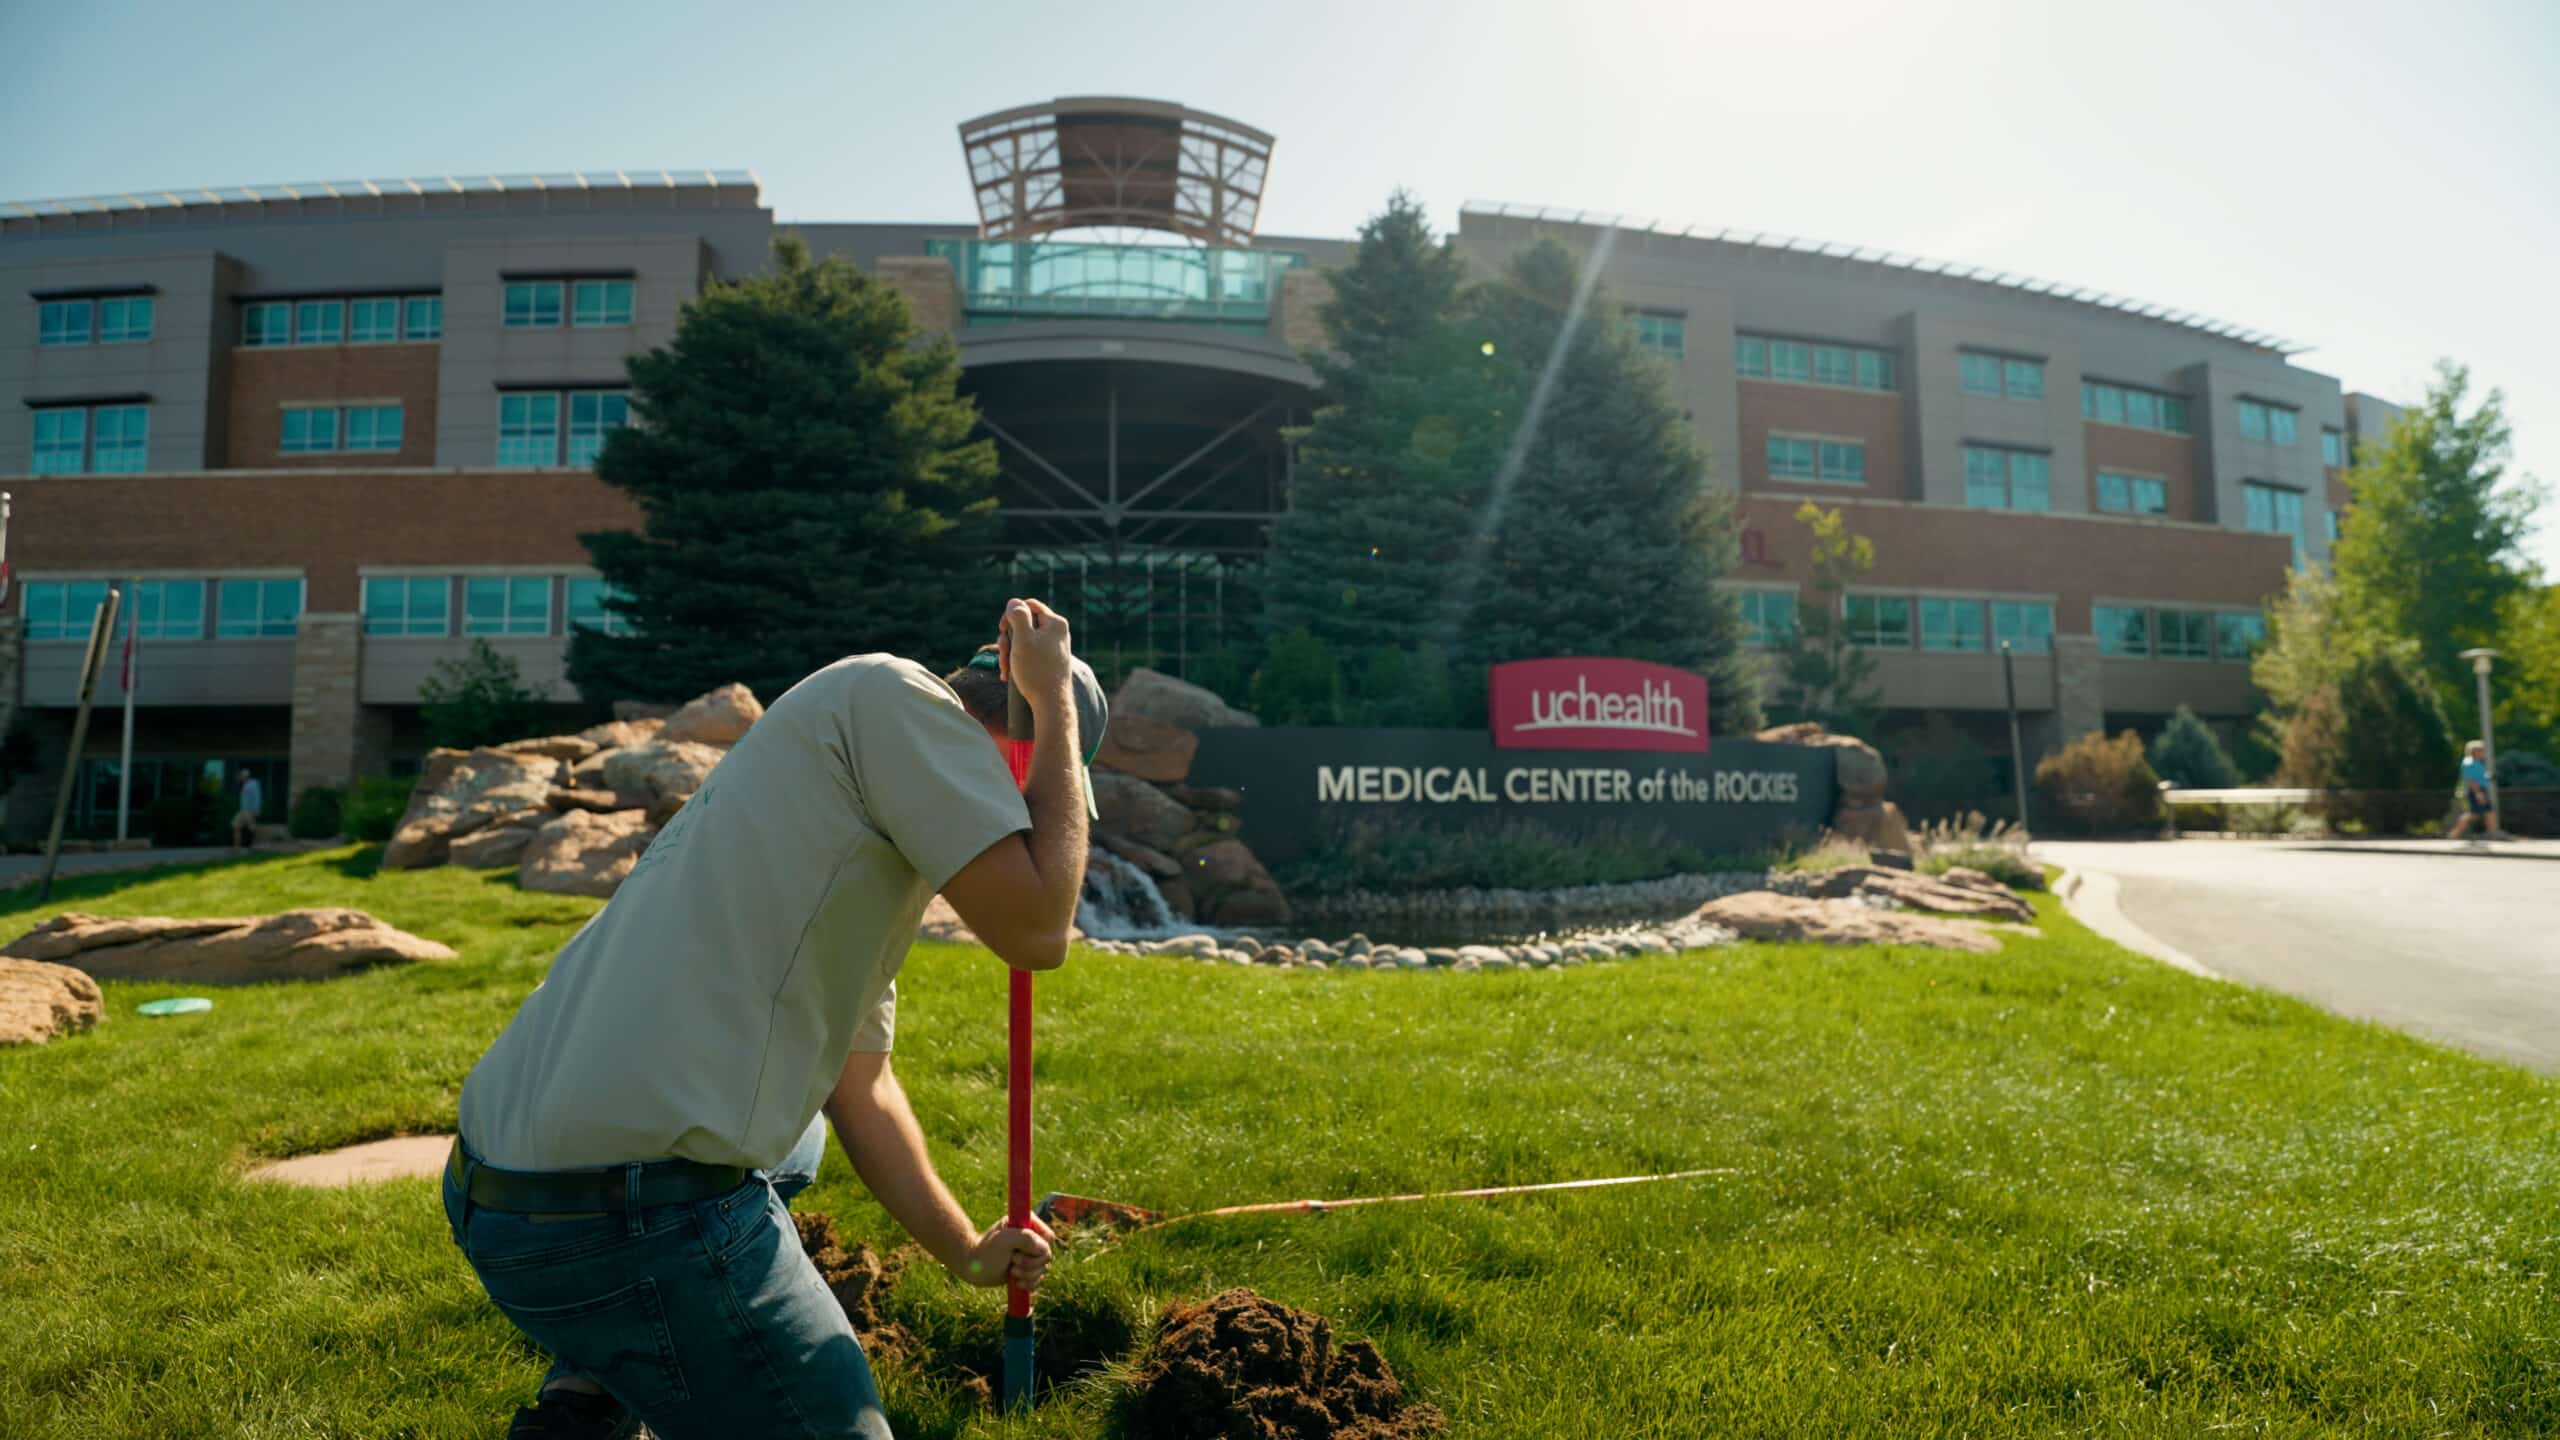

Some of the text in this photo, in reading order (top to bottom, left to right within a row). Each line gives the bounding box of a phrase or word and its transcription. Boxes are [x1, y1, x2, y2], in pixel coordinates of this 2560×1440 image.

[1531, 674, 1685, 730] uchealth
[1317, 766, 1799, 803] MEDICAL CENTER of the ROCKIES
